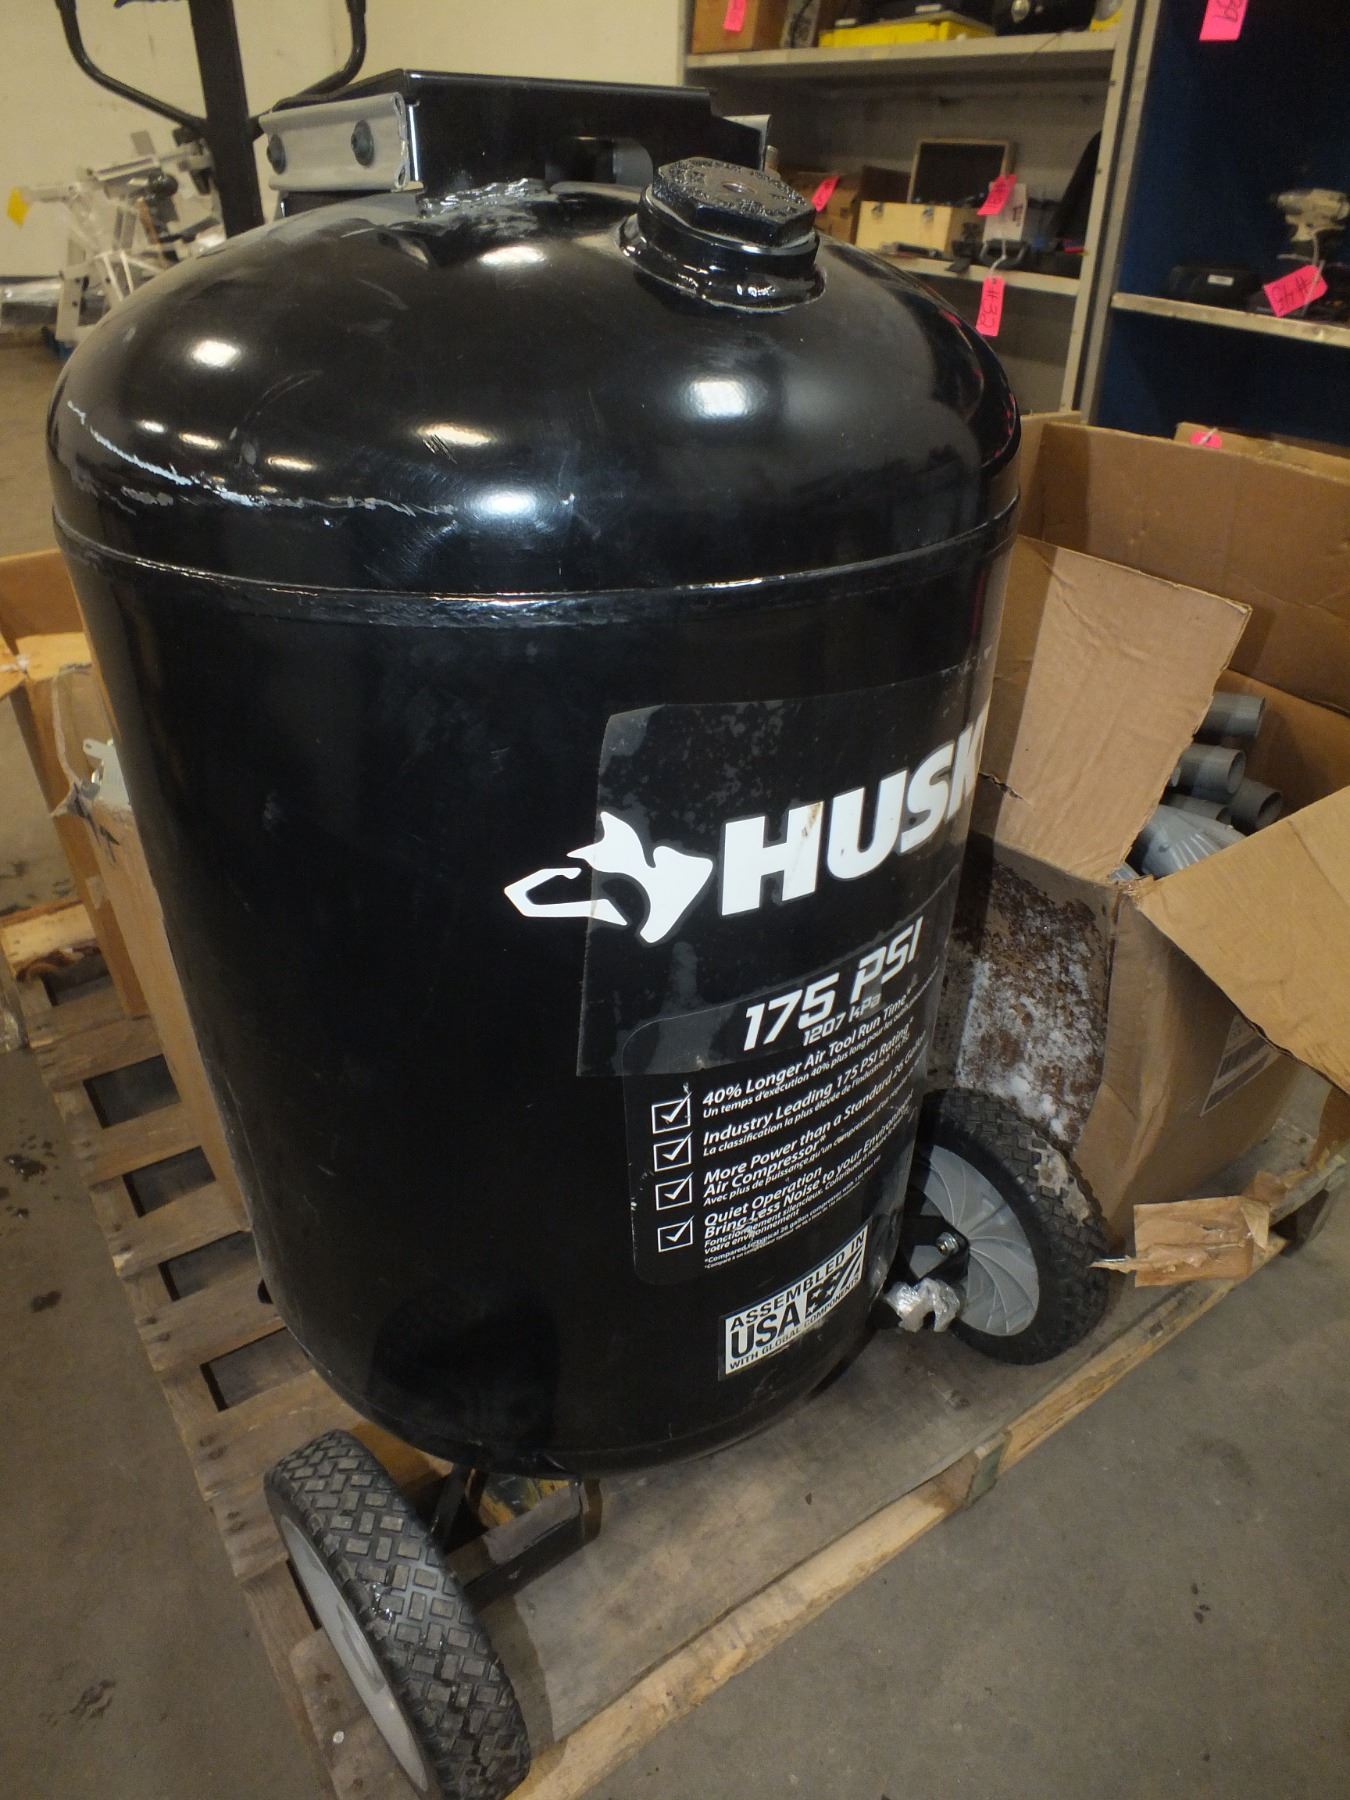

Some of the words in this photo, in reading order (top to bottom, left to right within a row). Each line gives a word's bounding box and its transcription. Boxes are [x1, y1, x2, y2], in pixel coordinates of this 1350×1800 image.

[744, 972, 842, 1051] 175
[850, 917, 924, 1005] PSI
[702, 1083, 742, 1106] 40%
[745, 1062, 803, 1094] Longer
[804, 1050, 826, 1070] Air
[829, 1029, 856, 1056] Tool
[858, 1016, 881, 1040] Run
[803, 1012, 846, 1046] 1207
[703, 1107, 719, 1118] Un
[721, 1095, 753, 1114] temps
[755, 1072, 809, 1102] d'exécution
[810, 1062, 830, 1077] 40%
[830, 1053, 848, 1069] plus
[849, 1041, 866, 1057] long
[703, 1112, 773, 1146] Industry
[775, 1083, 833, 1120] Leading
[837, 1064, 859, 1089] 175
[860, 1049, 879, 1073] PSI
[703, 1148, 716, 1157] La
[718, 1121, 782, 1152] classification
[783, 1117, 793, 1128] la
[794, 1107, 813, 1125] plus
[841, 1083, 851, 1096] de
[703, 1161, 747, 1185] More
[750, 1139, 798, 1169] Power
[799, 1121, 831, 1146] than
[833, 1114, 842, 1127] a
[844, 1070, 893, 1120] Standard
[703, 1180, 728, 1198] Air
[703, 1193, 728, 1207] Avec
[729, 1184, 750, 1200] plus
[751, 1179, 764, 1190] de
[704, 1217, 748, 1239] Bring
[749, 1201, 781, 1222] Less
[783, 1179, 820, 1208] Noise
[822, 1170, 834, 1184] to
[835, 1147, 862, 1177] your
[704, 1202, 749, 1227] Quiet
[751, 1166, 823, 1209] Operation
[704, 1242, 730, 1255] votre
[730, 1252, 845, 1331] ASSEMBLED
[850, 1229, 866, 1254] IN
[729, 1350, 758, 1370] WITH
[762, 1327, 802, 1355] GLOBAL
[731, 1302, 801, 1360] USA
